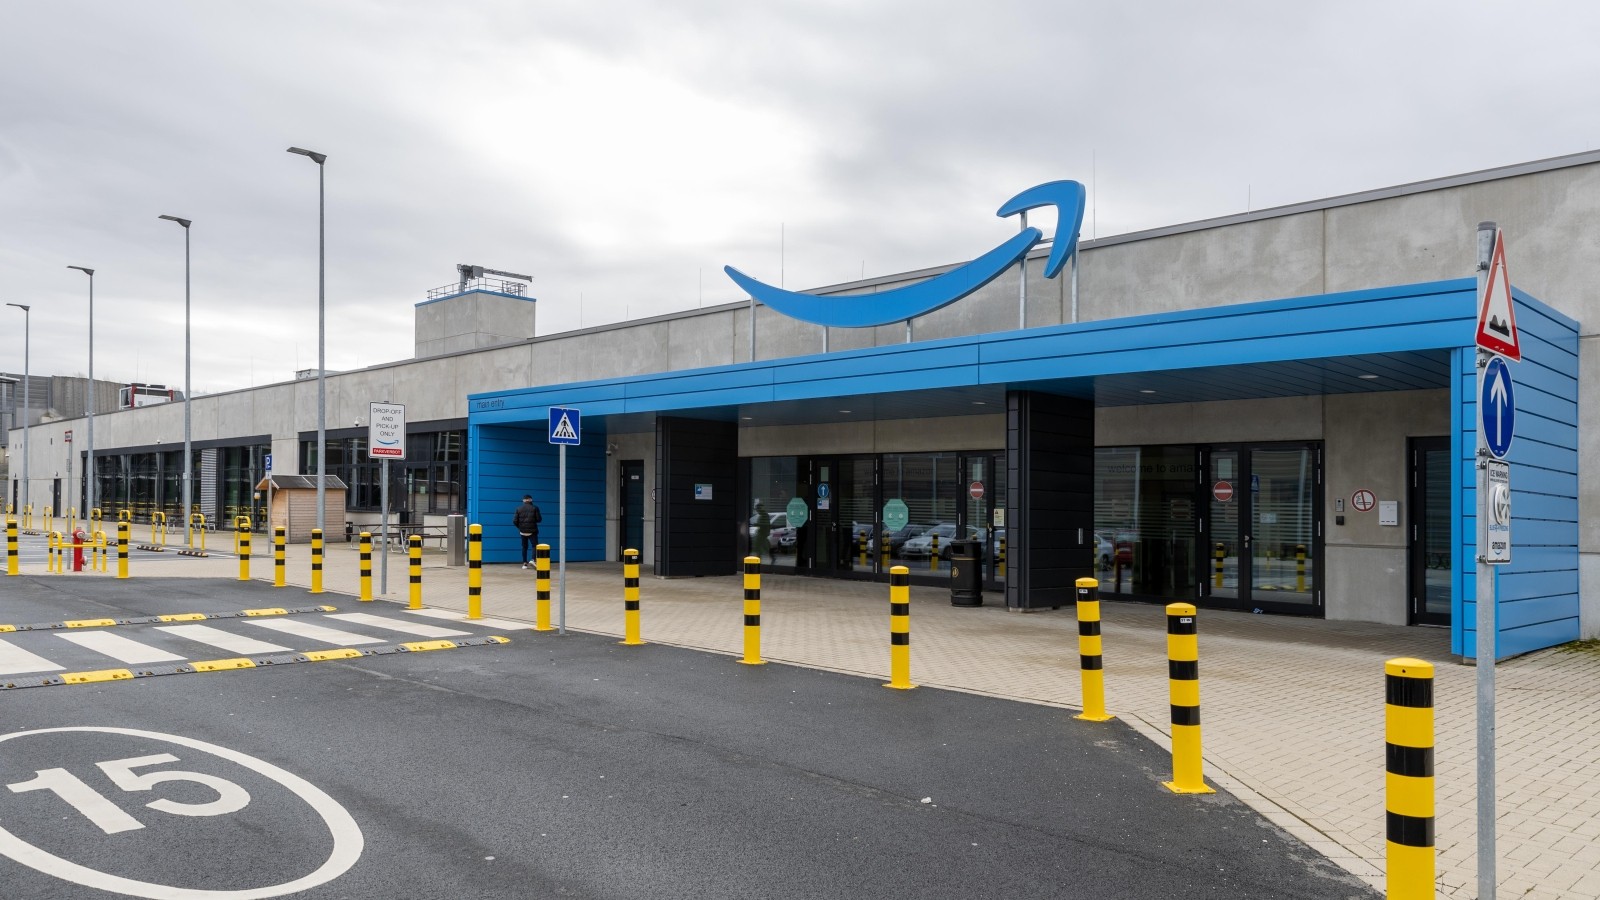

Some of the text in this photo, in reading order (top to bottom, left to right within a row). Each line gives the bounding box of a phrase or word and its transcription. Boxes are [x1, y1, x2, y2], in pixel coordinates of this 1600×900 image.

[477, 398, 505, 409] main entry
[373, 407, 402, 415] DROP-OFF
[1107, 463, 1195, 474] welcome to ama
[1496, 470, 1508, 480] WARNING
[1491, 541, 1507, 550] amazon
[6, 753, 251, 835] 15
